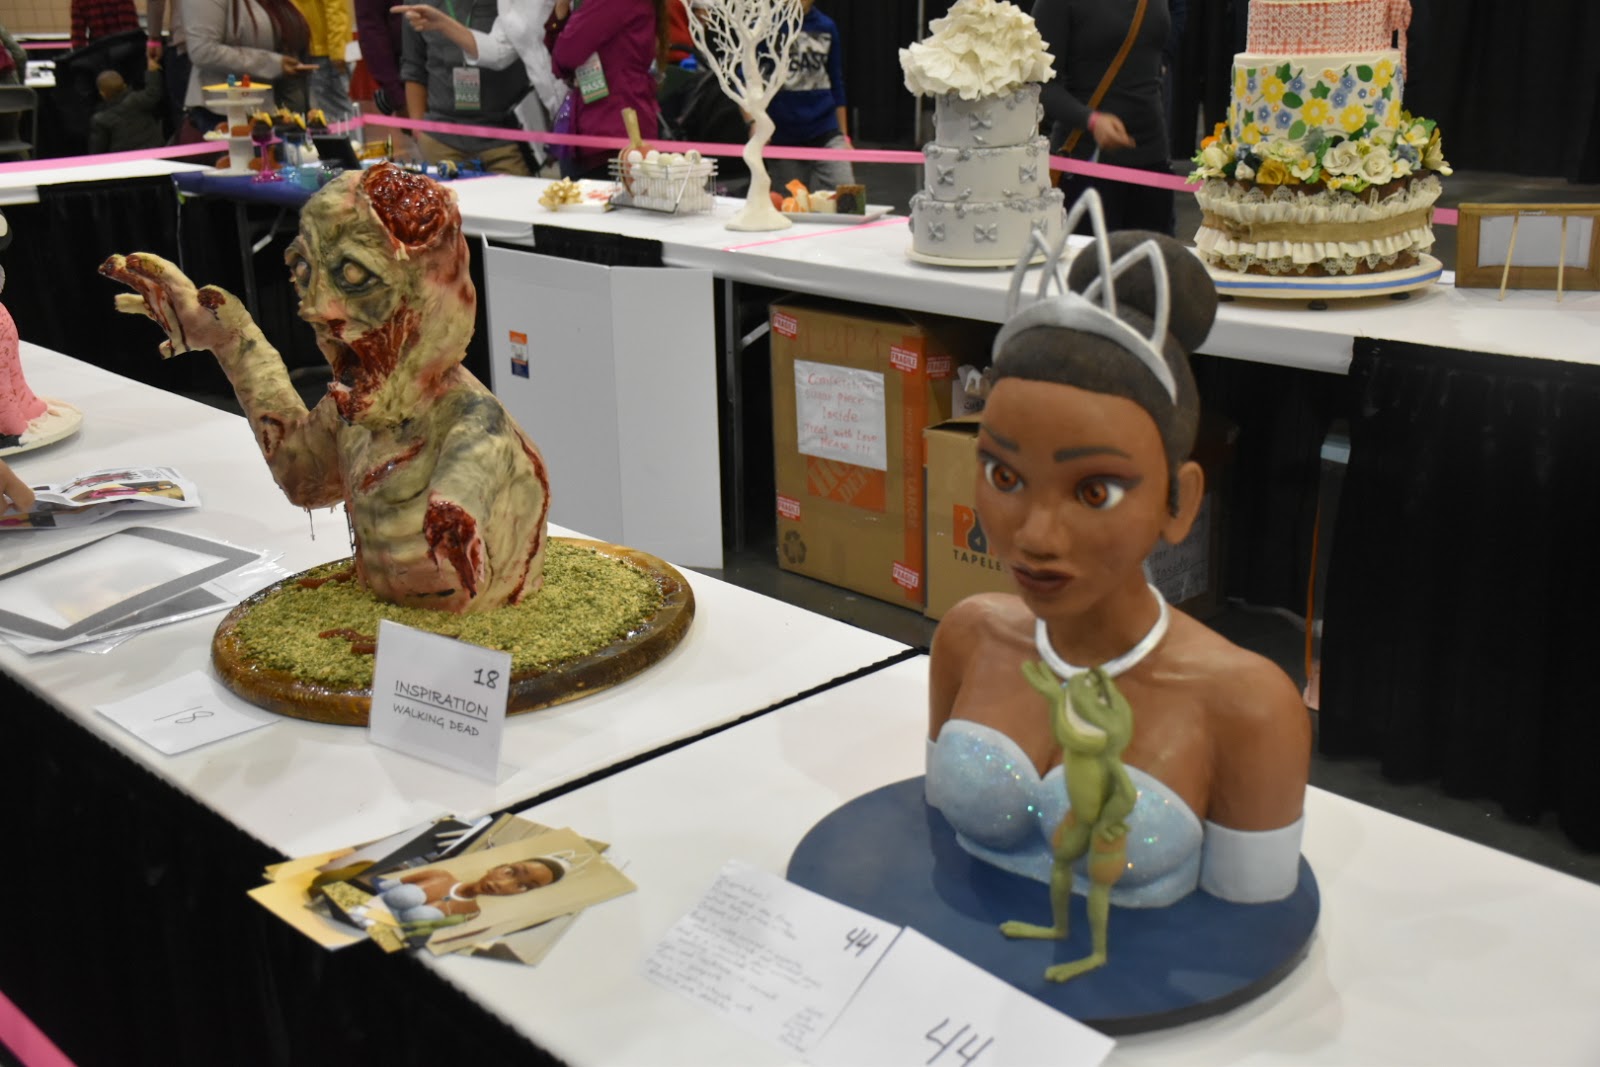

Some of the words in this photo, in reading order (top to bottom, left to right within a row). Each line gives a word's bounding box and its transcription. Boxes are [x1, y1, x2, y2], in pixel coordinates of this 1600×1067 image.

[773, 316, 798, 335] FRAGILE
[890, 352, 918, 369] FRAGILE
[777, 500, 800, 517] FRAGILE
[953, 549, 1003, 572] TAPELE
[892, 566, 919, 588] FRAGILE
[473, 667, 500, 690] 18
[394, 679, 489, 719] INSPIRATION
[392, 702, 445, 729] WALKING
[449, 719, 480, 737] DEAD
[843, 926, 879, 958] 44
[924, 1017, 995, 1067] 44
